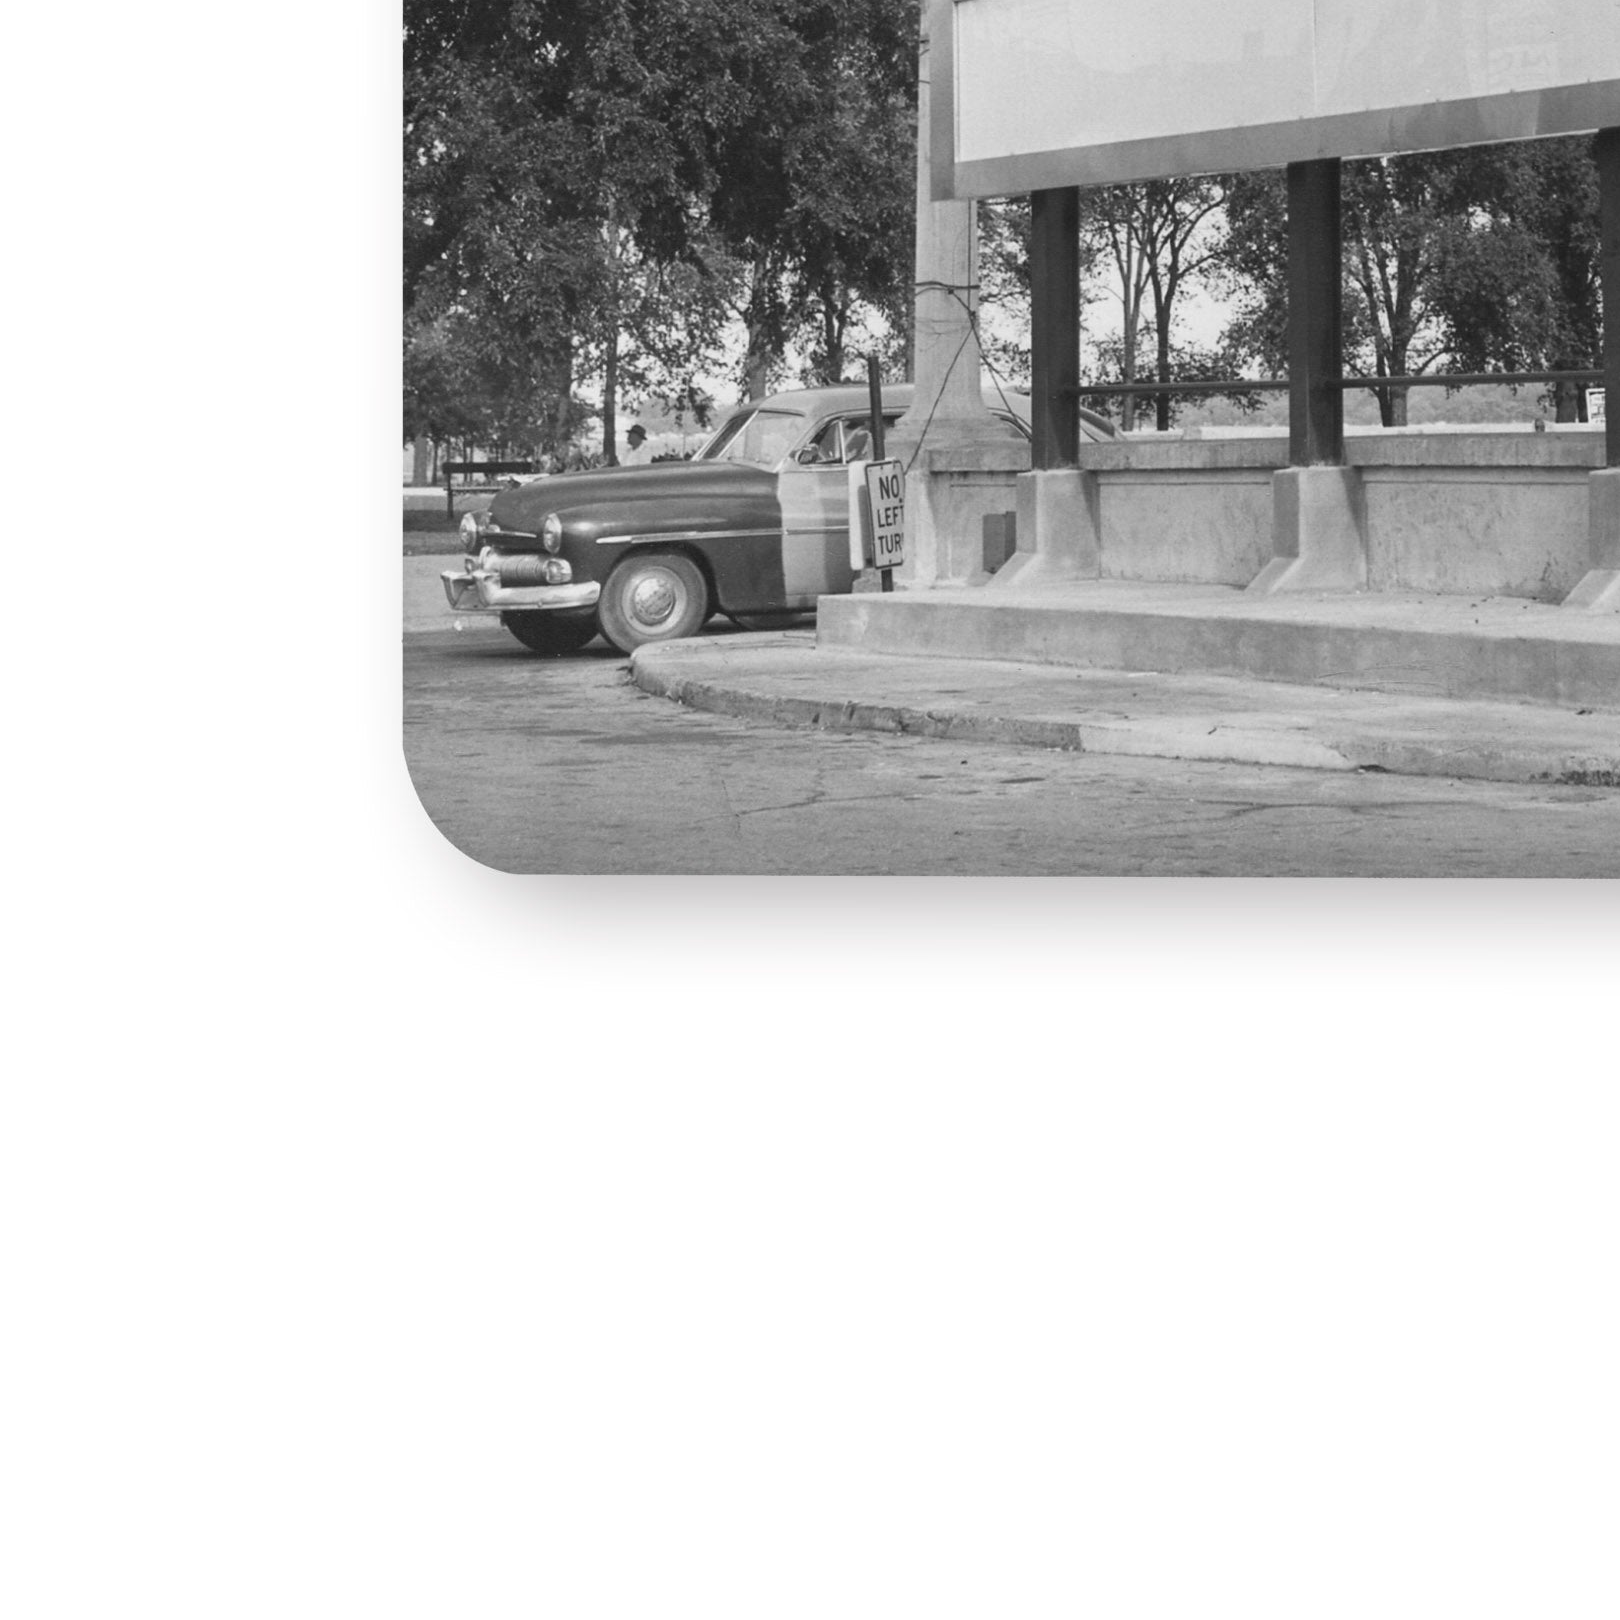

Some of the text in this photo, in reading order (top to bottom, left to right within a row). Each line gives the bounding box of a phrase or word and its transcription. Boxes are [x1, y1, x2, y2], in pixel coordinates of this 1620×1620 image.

[879, 474, 900, 500] NO
[877, 505, 904, 528] LEFT
[877, 532, 904, 555] TUR
